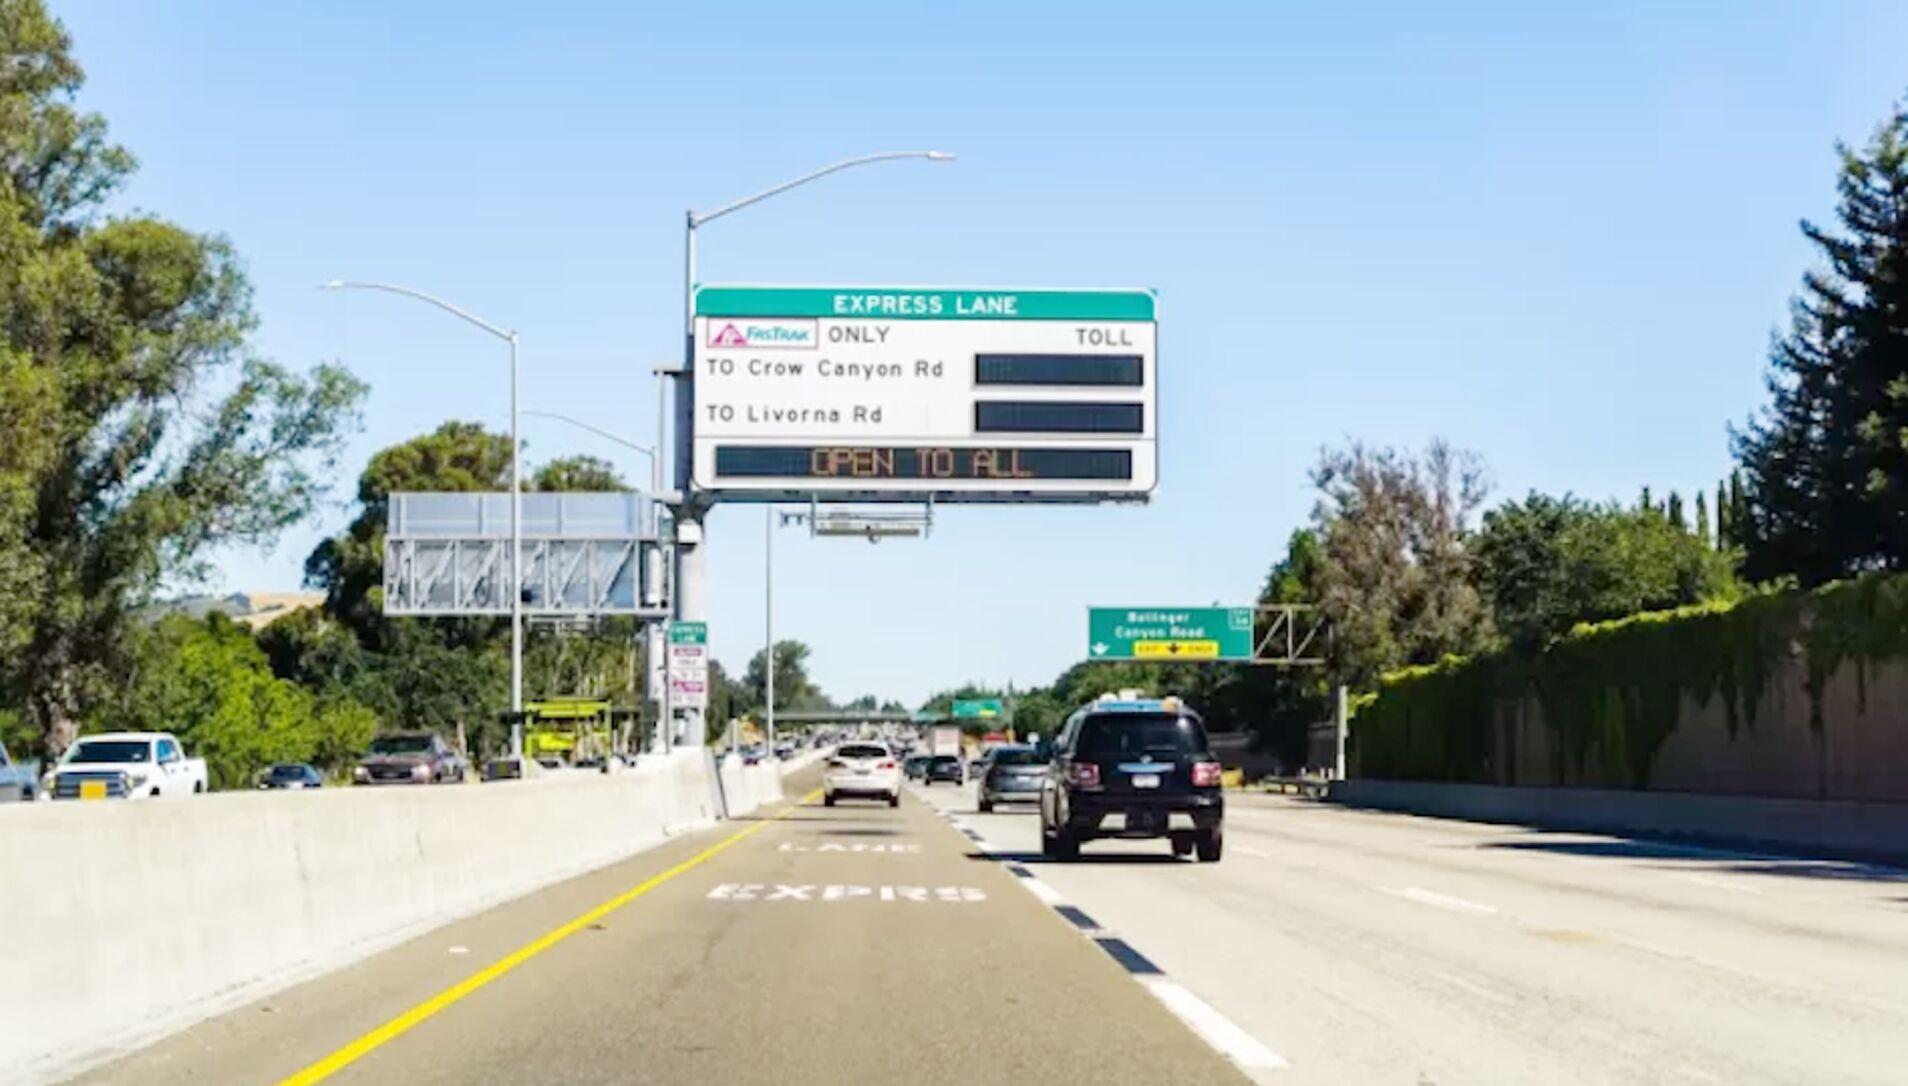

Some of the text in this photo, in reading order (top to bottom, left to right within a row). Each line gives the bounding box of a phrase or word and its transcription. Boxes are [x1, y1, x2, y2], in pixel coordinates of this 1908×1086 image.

[833, 294, 1019, 315] EXPRESS LANE
[828, 326, 891, 343] ONLY
[1076, 328, 1133, 346] TOLL
[706, 358, 943, 380] TO Crow Canyon Rd
[706, 404, 883, 423] TO Livorna Rd
[811, 447, 1034, 478] OPEN TO ALL
[1114, 625, 1205, 640] Canyon Road
[777, 842, 923, 853] LANE
[705, 883, 988, 902] EXPRS
